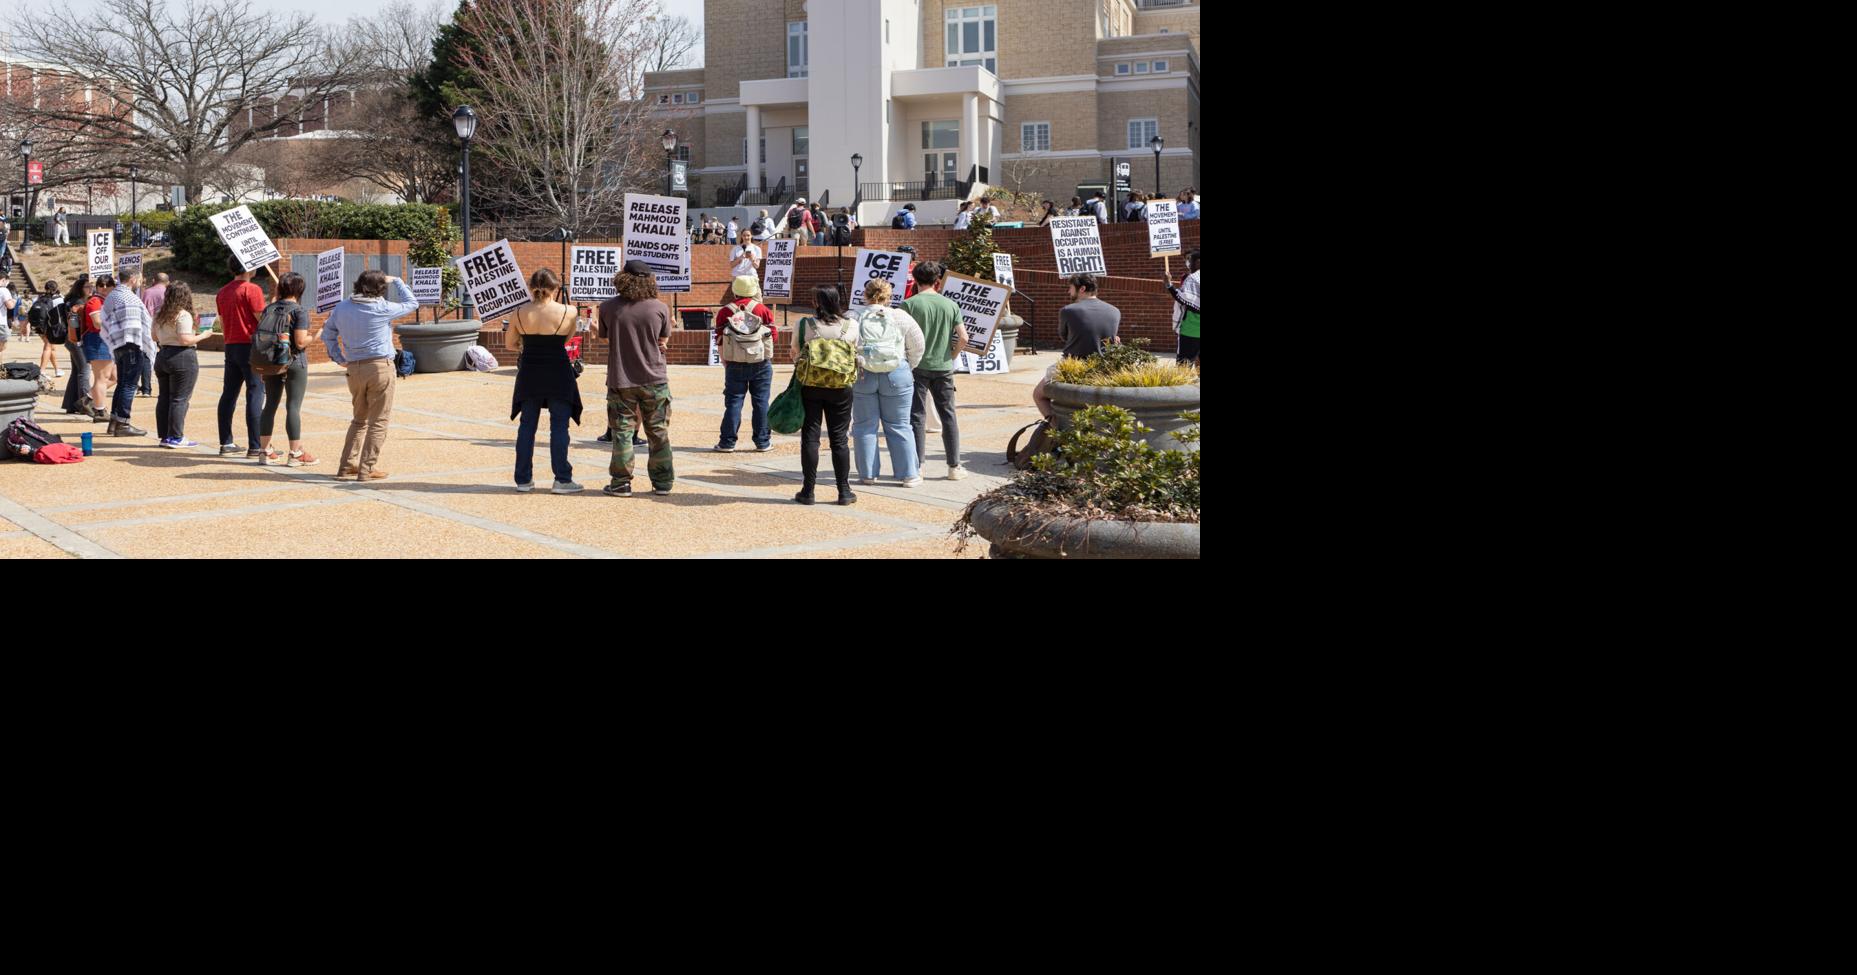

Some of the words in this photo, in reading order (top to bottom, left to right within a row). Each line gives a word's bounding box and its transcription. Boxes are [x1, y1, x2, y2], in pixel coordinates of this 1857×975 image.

[630, 202, 680, 215] RELEASE
[1156, 203, 1170, 212] THE
[222, 211, 243, 224] THE
[629, 213, 680, 224] MAHMOUD
[1052, 218, 1096, 228] RESISTANCE
[222, 217, 255, 234] MOVEMENT
[225, 224, 259, 240] CONTINUES
[632, 223, 676, 236] KHALIL
[1060, 228, 1090, 237] AGAINST
[93, 233, 109, 246] ICE
[241, 236, 258, 247] UNTIL
[627, 240, 660, 250] HANDS
[661, 243, 679, 252] OFF
[1055, 237, 1099, 247] OCCUPATION
[96, 246, 107, 255] OFF
[240, 240, 268, 255] PALESTINE
[255, 248, 268, 257] FREE
[775, 242, 788, 251] THE
[1058, 249, 1065, 257] IS
[1073, 247, 1100, 256] HUMAN
[94, 256, 108, 265] OUR
[320, 252, 341, 266] RELEASE
[464, 246, 508, 278] FREE
[576, 250, 615, 265] FREE
[643, 251, 679, 260] STUDENTS
[864, 253, 902, 271] ICE
[996, 256, 1009, 266] FREE
[319, 261, 341, 273] MAHMOUD
[573, 265, 618, 273] PALESTINE
[1060, 256, 1103, 273] RIGHT!
[320, 270, 339, 284] KHALIL
[468, 263, 515, 289] PALESTINE
[574, 277, 594, 286] END
[869, 270, 894, 280] OFF
[318, 284, 332, 294] HANDS
[332, 281, 341, 290] OFF
[474, 287, 498, 305] END
[498, 278, 520, 294] THE
[961, 282, 991, 298] THE
[478, 289, 528, 314] OCCUPATION
[943, 290, 1000, 308] MOVEMENT
[957, 301, 997, 316] NTINUES
[976, 360, 1000, 371] ICE
